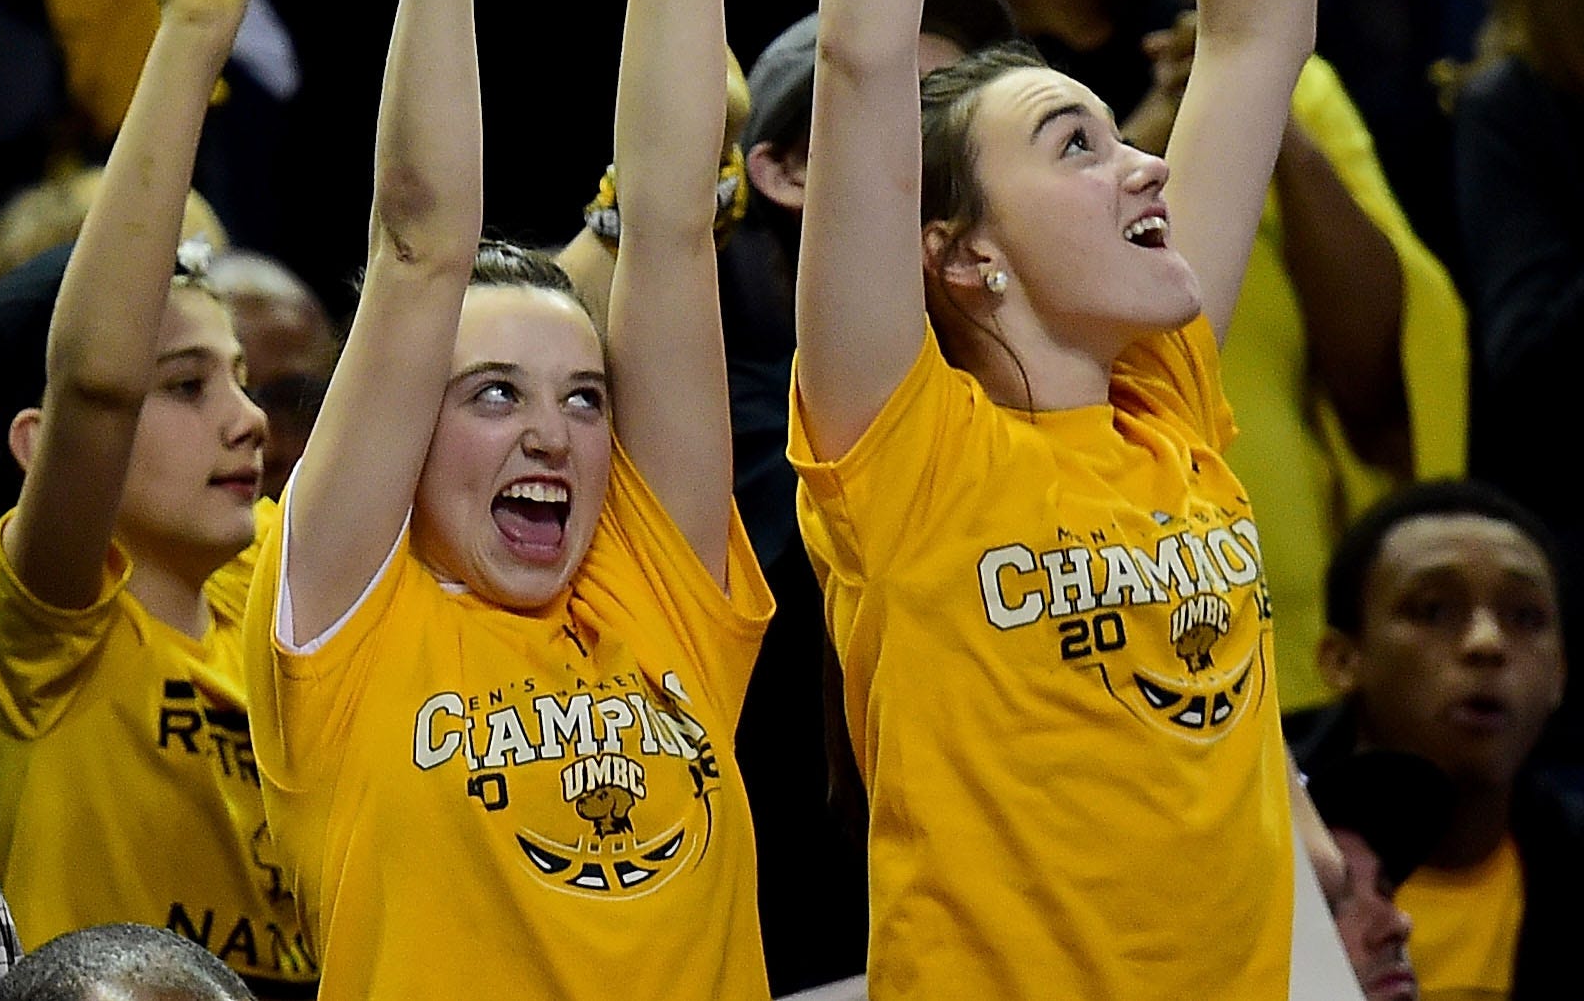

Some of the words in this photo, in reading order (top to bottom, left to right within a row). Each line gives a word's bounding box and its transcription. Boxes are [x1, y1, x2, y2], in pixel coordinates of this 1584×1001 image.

[1057, 610, 1127, 660] 20
[1169, 592, 1232, 645] UMBC
[560, 752, 647, 803] UMBC
